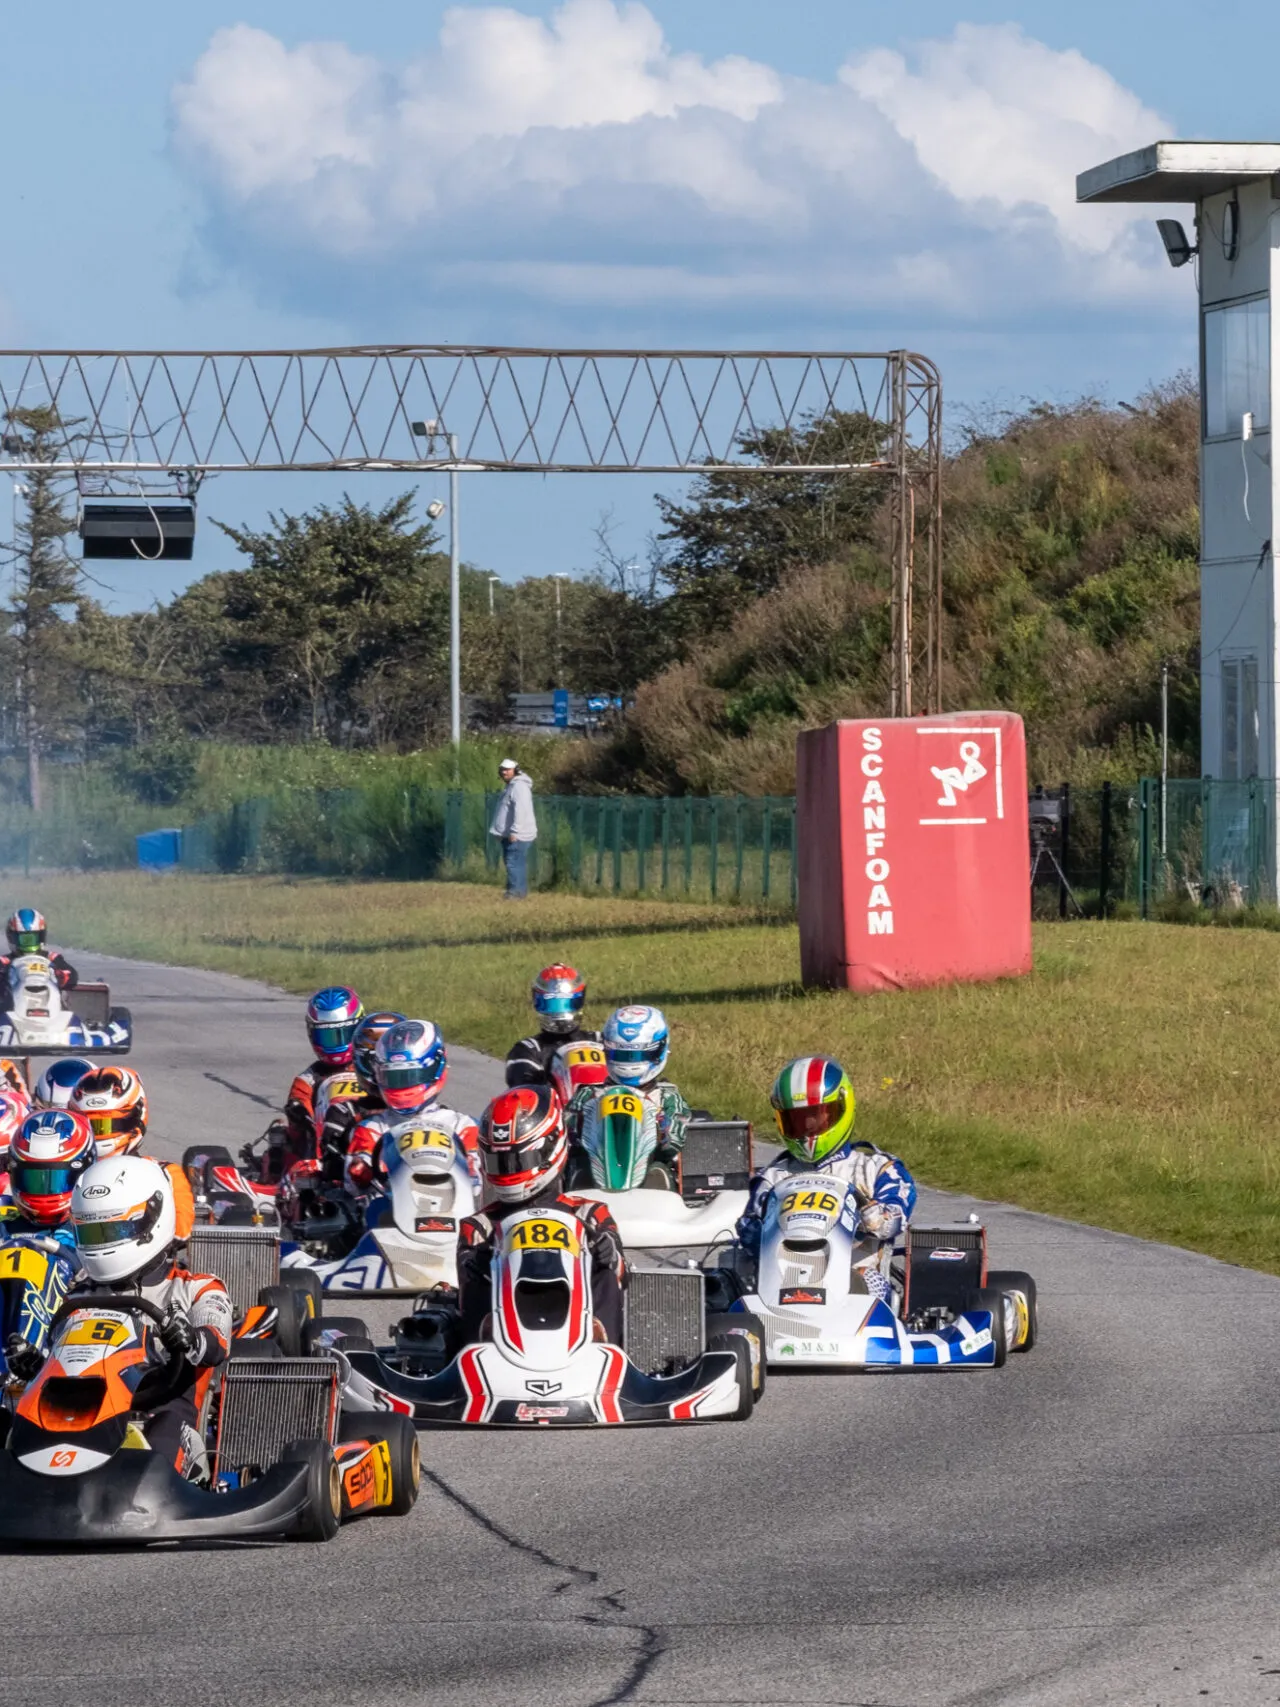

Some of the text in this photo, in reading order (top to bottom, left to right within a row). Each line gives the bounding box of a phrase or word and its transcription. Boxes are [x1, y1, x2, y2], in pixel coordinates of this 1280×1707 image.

[860, 727, 894, 936] SCANFOAM
[576, 1050, 601, 1063] 10
[335, 1080, 363, 1095] 78
[608, 1096, 635, 1113] 16
[400, 1130, 452, 1152] 313
[86, 1186, 107, 1196] Arai
[781, 1192, 838, 1214] 346
[512, 1224, 570, 1248] 184
[6, 1250, 22, 1273] 1
[91, 1322, 117, 1340] 5
[378, 1445, 389, 1502] 5
